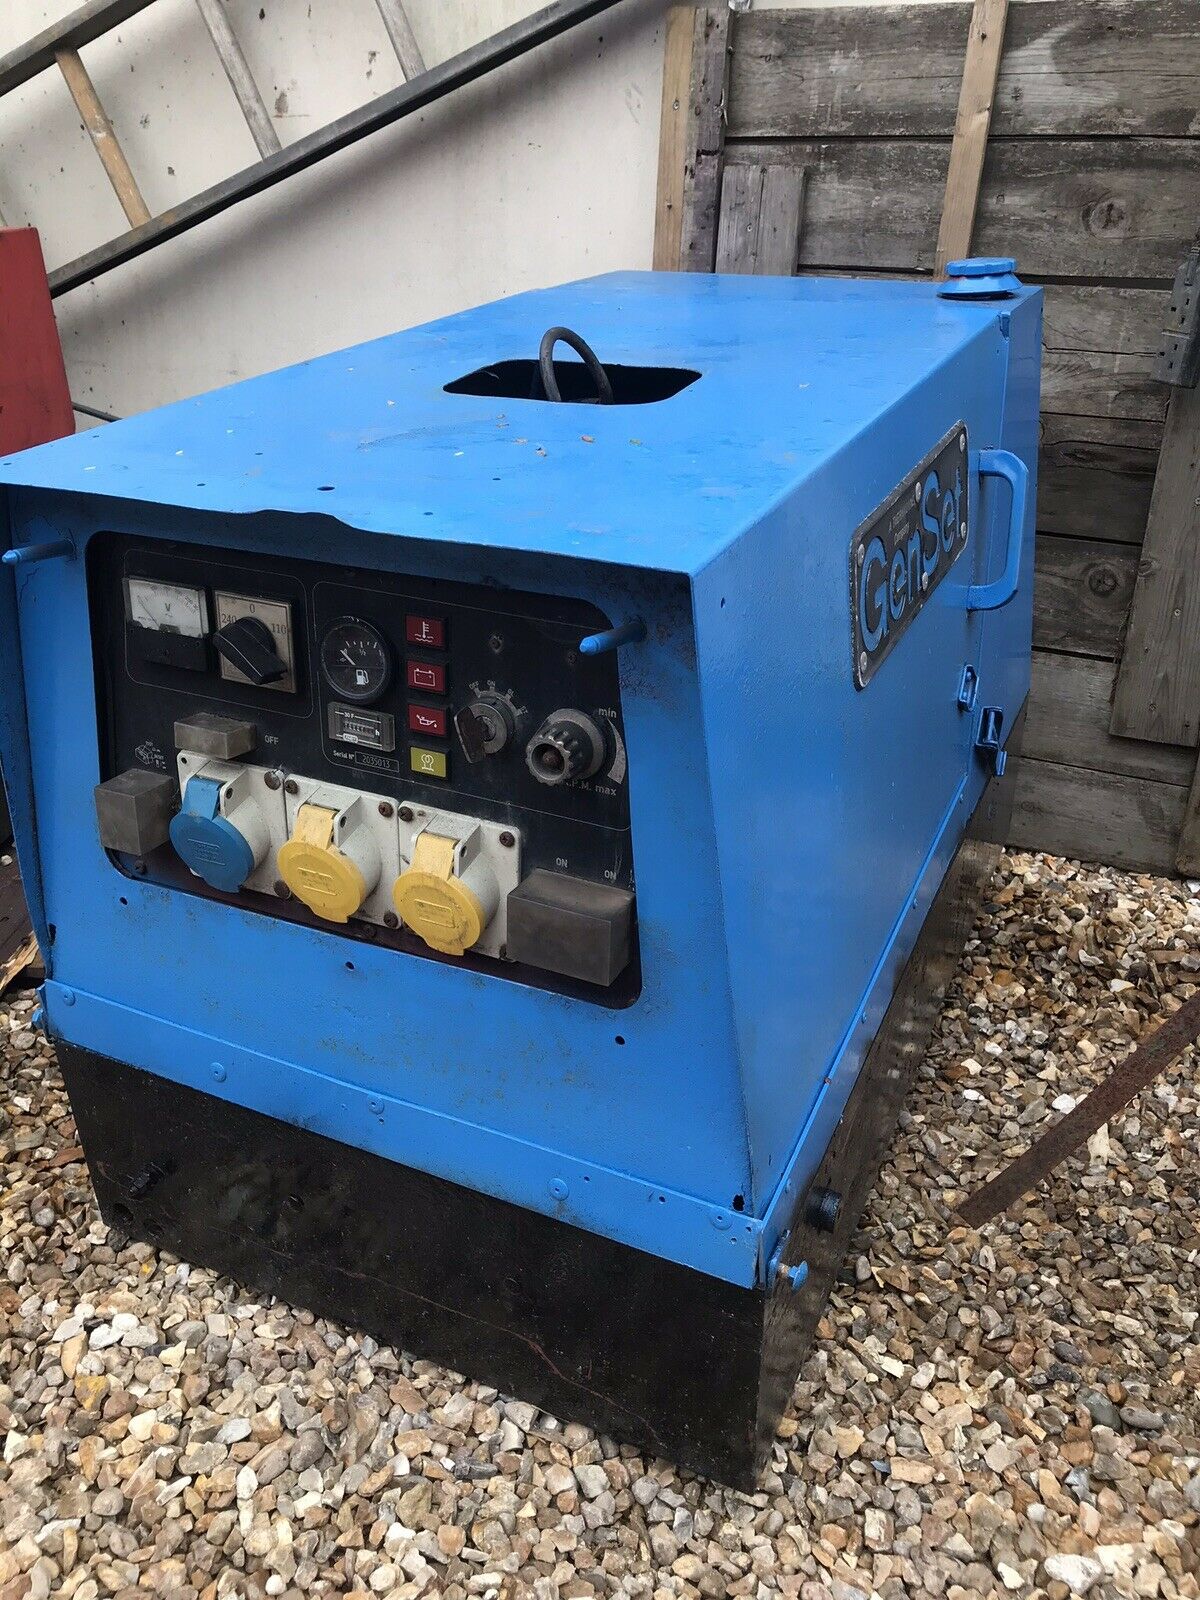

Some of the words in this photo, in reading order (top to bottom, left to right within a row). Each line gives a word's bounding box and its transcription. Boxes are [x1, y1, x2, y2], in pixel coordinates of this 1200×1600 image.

[859, 466, 964, 652] GenSet
[221, 613, 237, 624] 240
[271, 623, 287, 634] 110
[598, 707, 617, 718] min
[264, 734, 279, 745] OFF
[333, 750, 348, 759] Serial
[595, 784, 617, 796] max
[555, 857, 568, 868] ON
[604, 869, 617, 880] ON
